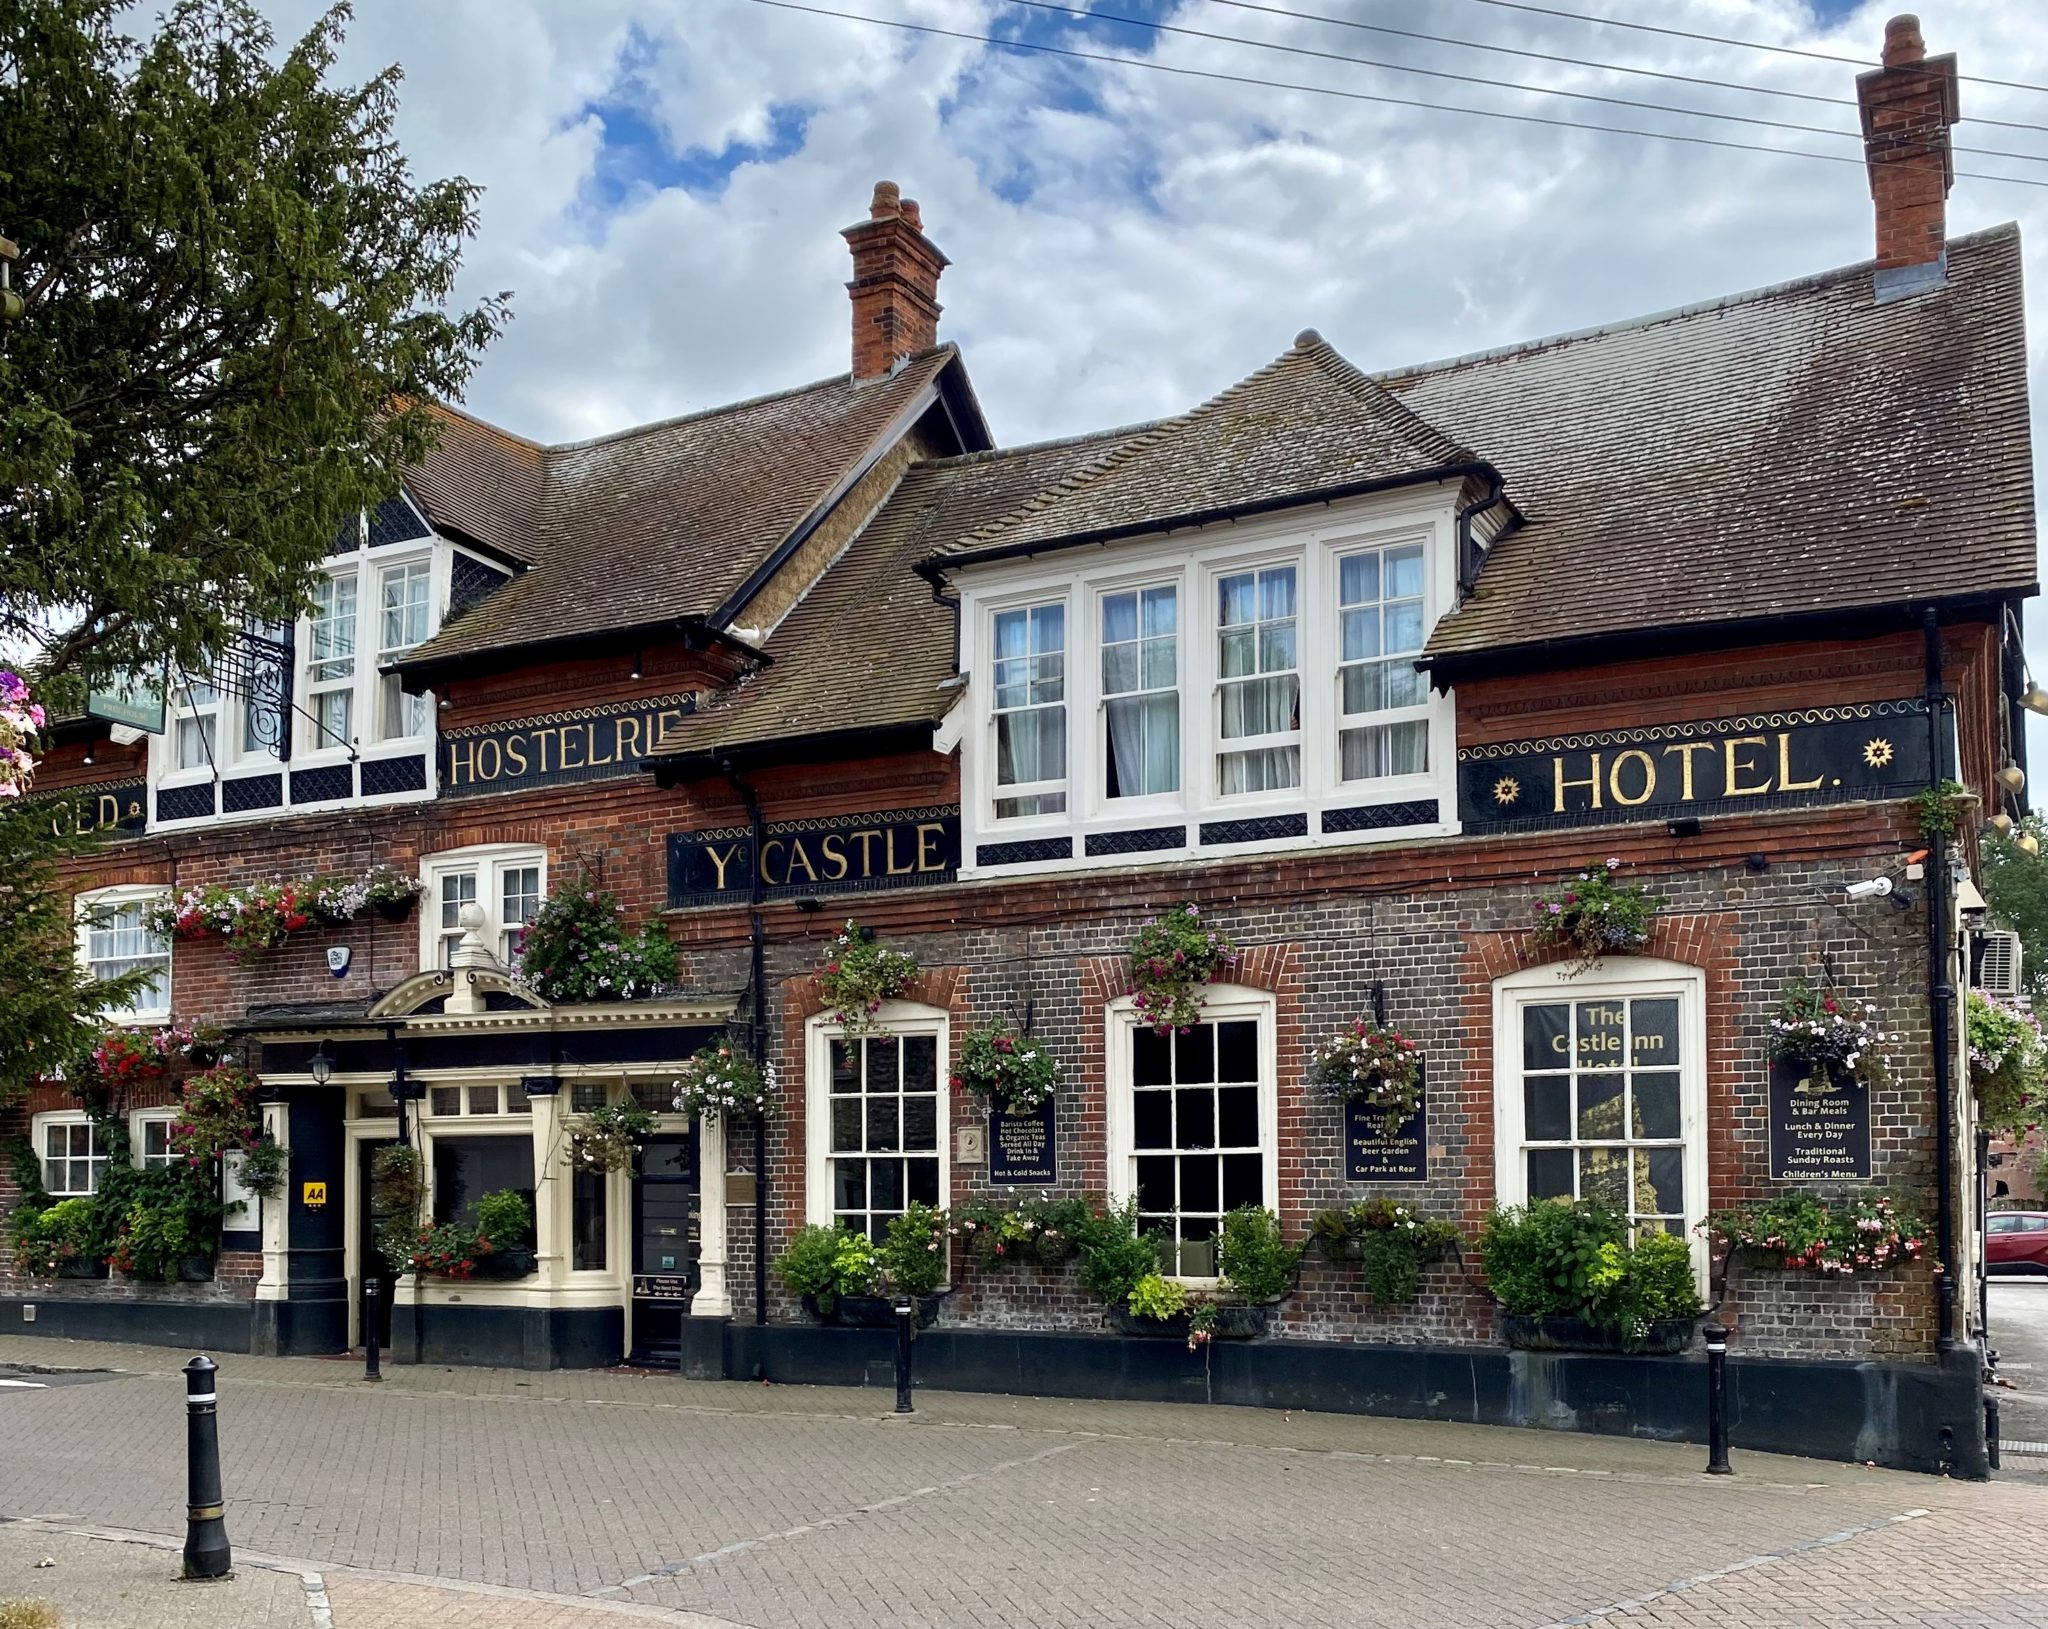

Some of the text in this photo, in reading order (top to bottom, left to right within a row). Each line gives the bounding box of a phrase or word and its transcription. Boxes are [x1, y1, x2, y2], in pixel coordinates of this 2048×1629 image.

[1552, 733, 1841, 812] HOTEL.
[760, 822, 948, 885] CASTLE
[1585, 1006, 1624, 1026] The
[1552, 1032, 1664, 1052] Cstle nn
[1790, 1100, 1819, 1108] Dining
[1820, 1107, 1847, 1115] Meals
[1824, 1122, 1855, 1130] Dinner
[1798, 1131, 1843, 1140] Every Day
[1390, 1138, 1418, 1146] English
[1795, 1147, 1846, 1155] Traditional
[1788, 1156, 1820, 1165] Sunday
[1783, 1170, 1857, 1178] Children's Menu
[307, 1188, 323, 1200] AA
